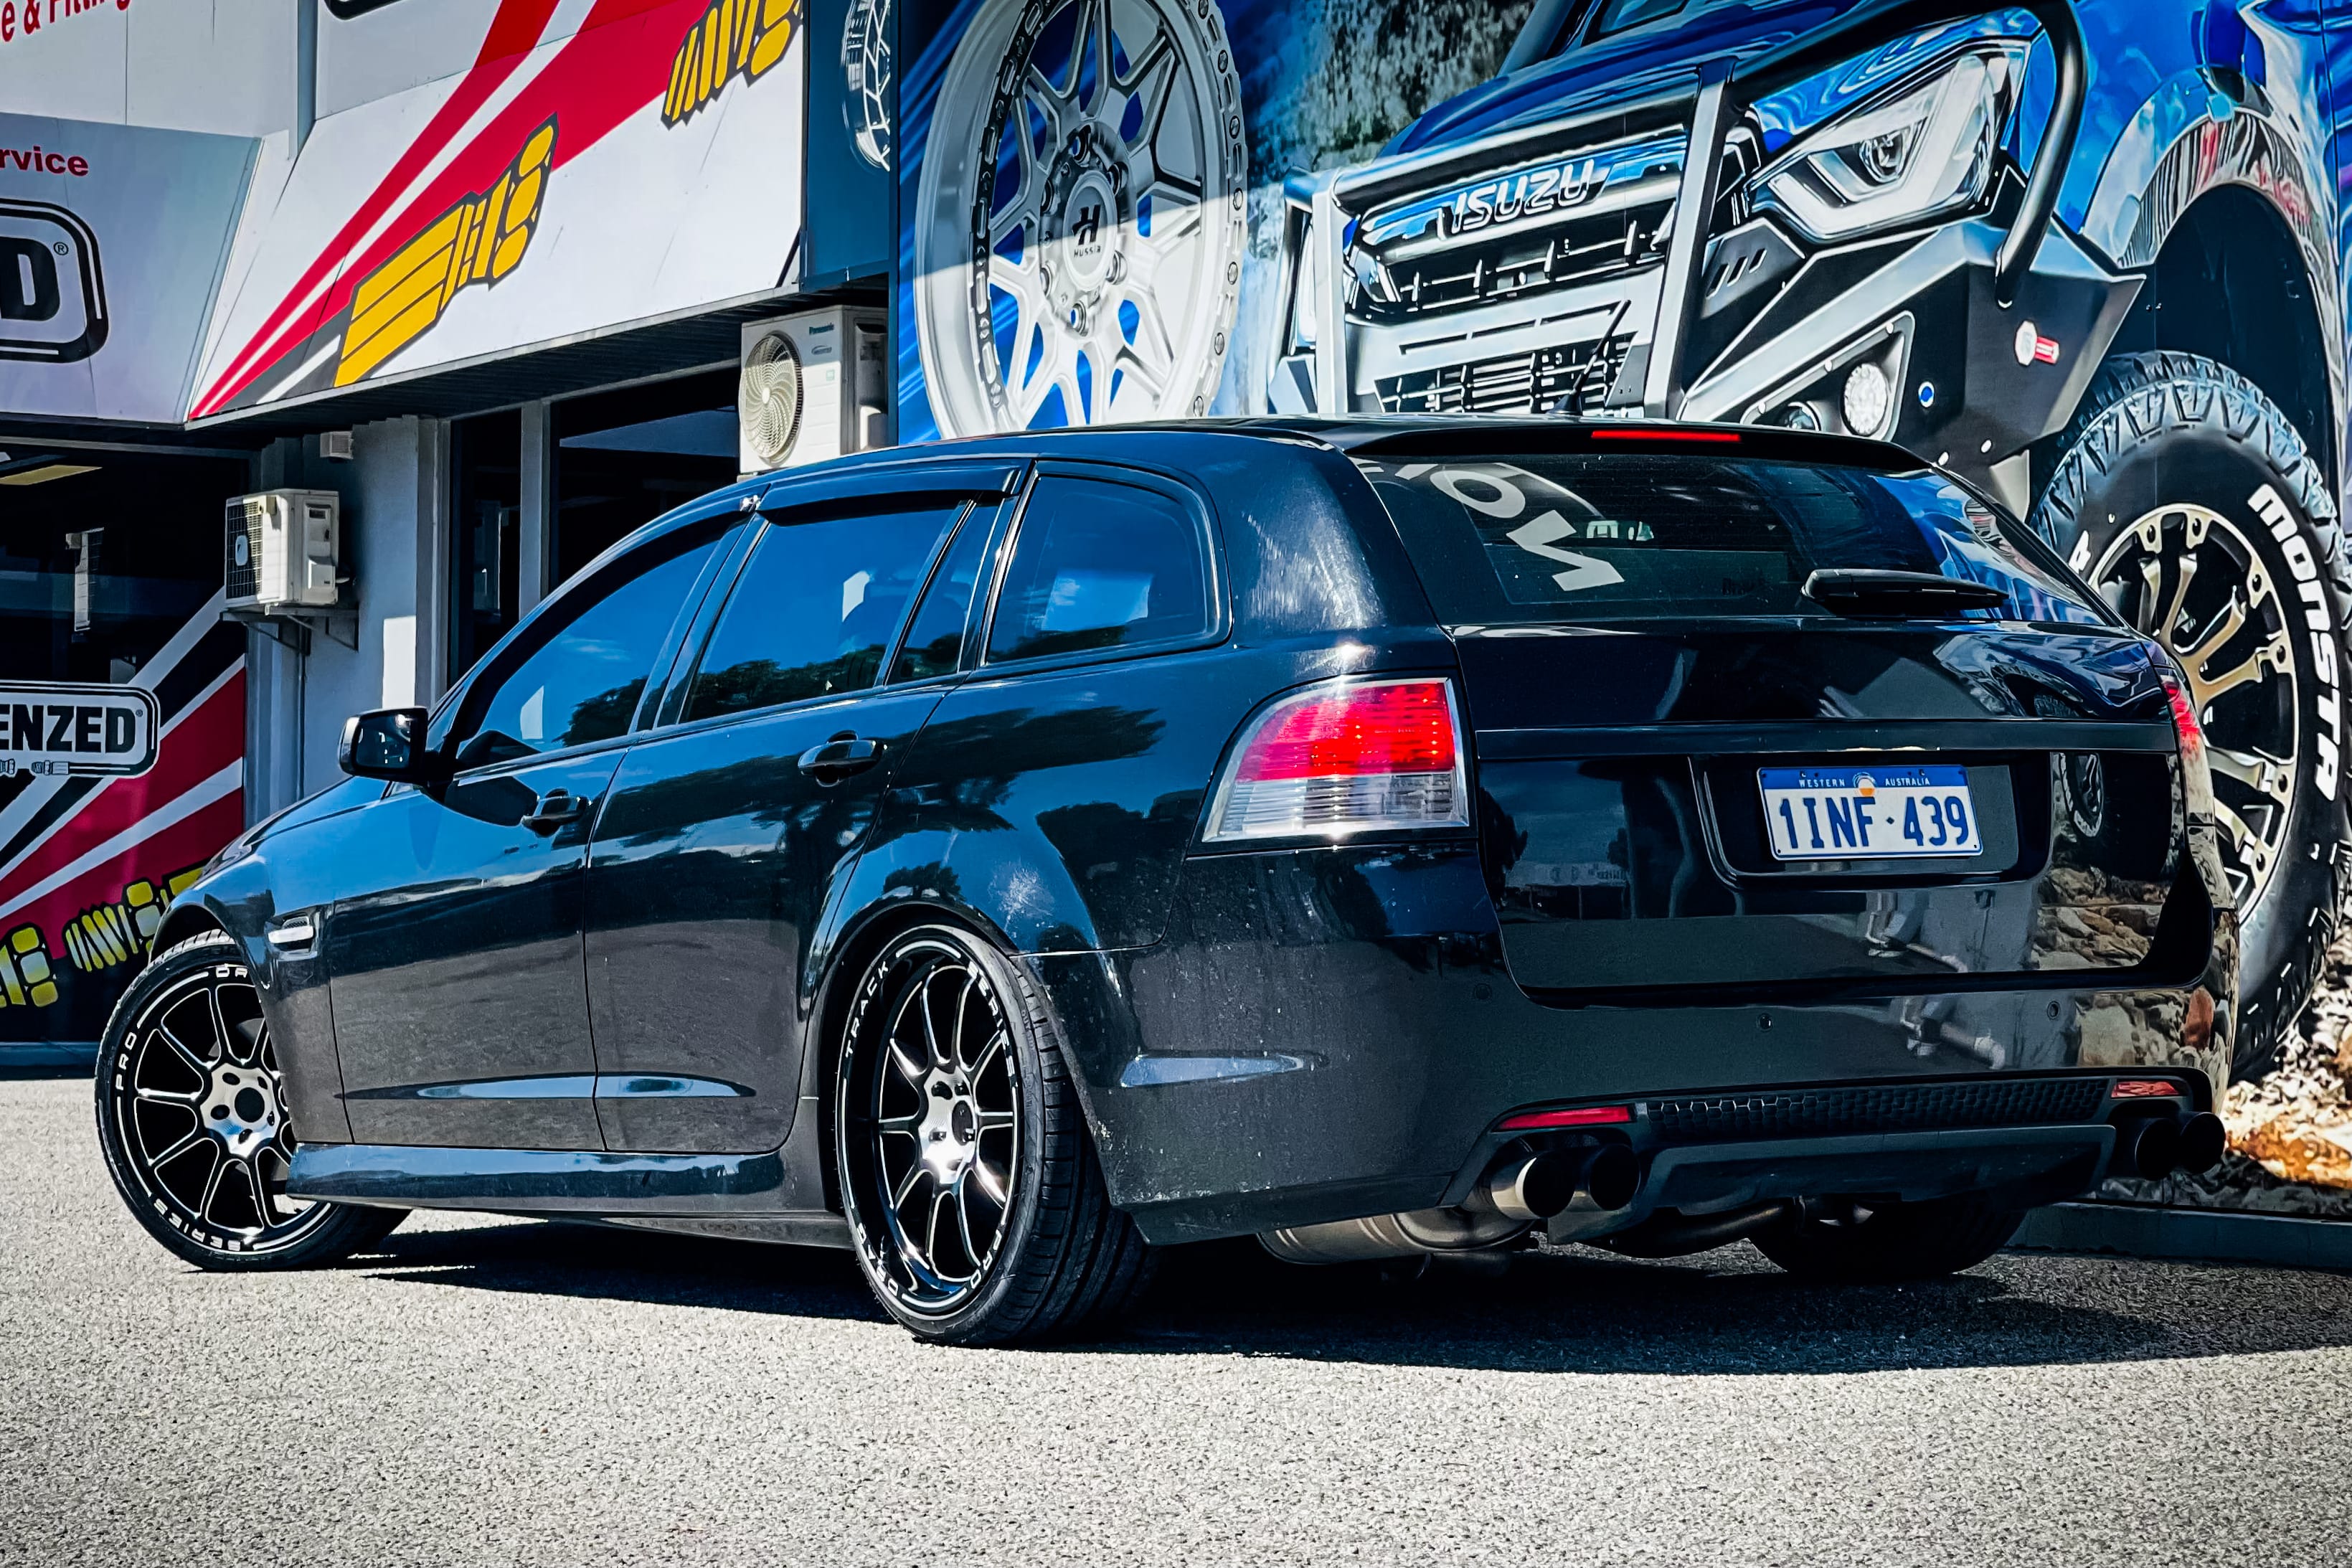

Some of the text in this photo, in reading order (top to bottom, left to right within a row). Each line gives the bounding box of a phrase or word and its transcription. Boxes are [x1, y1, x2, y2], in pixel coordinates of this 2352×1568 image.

[0, 146, 88, 176] rvice
[1451, 159, 1595, 234] ISUZU
[2247, 483, 2341, 801] MONSTA
[1799, 777, 1930, 788] WESTERN AUSTRALIA
[845, 961, 888, 1057] TRACK
[968, 961, 1016, 1077] SERIES
[115, 1032, 137, 1090] PRO
[154, 1199, 241, 1252] SERIES
[857, 1222, 898, 1296] DRAG
[970, 1229, 1002, 1289] PRO
